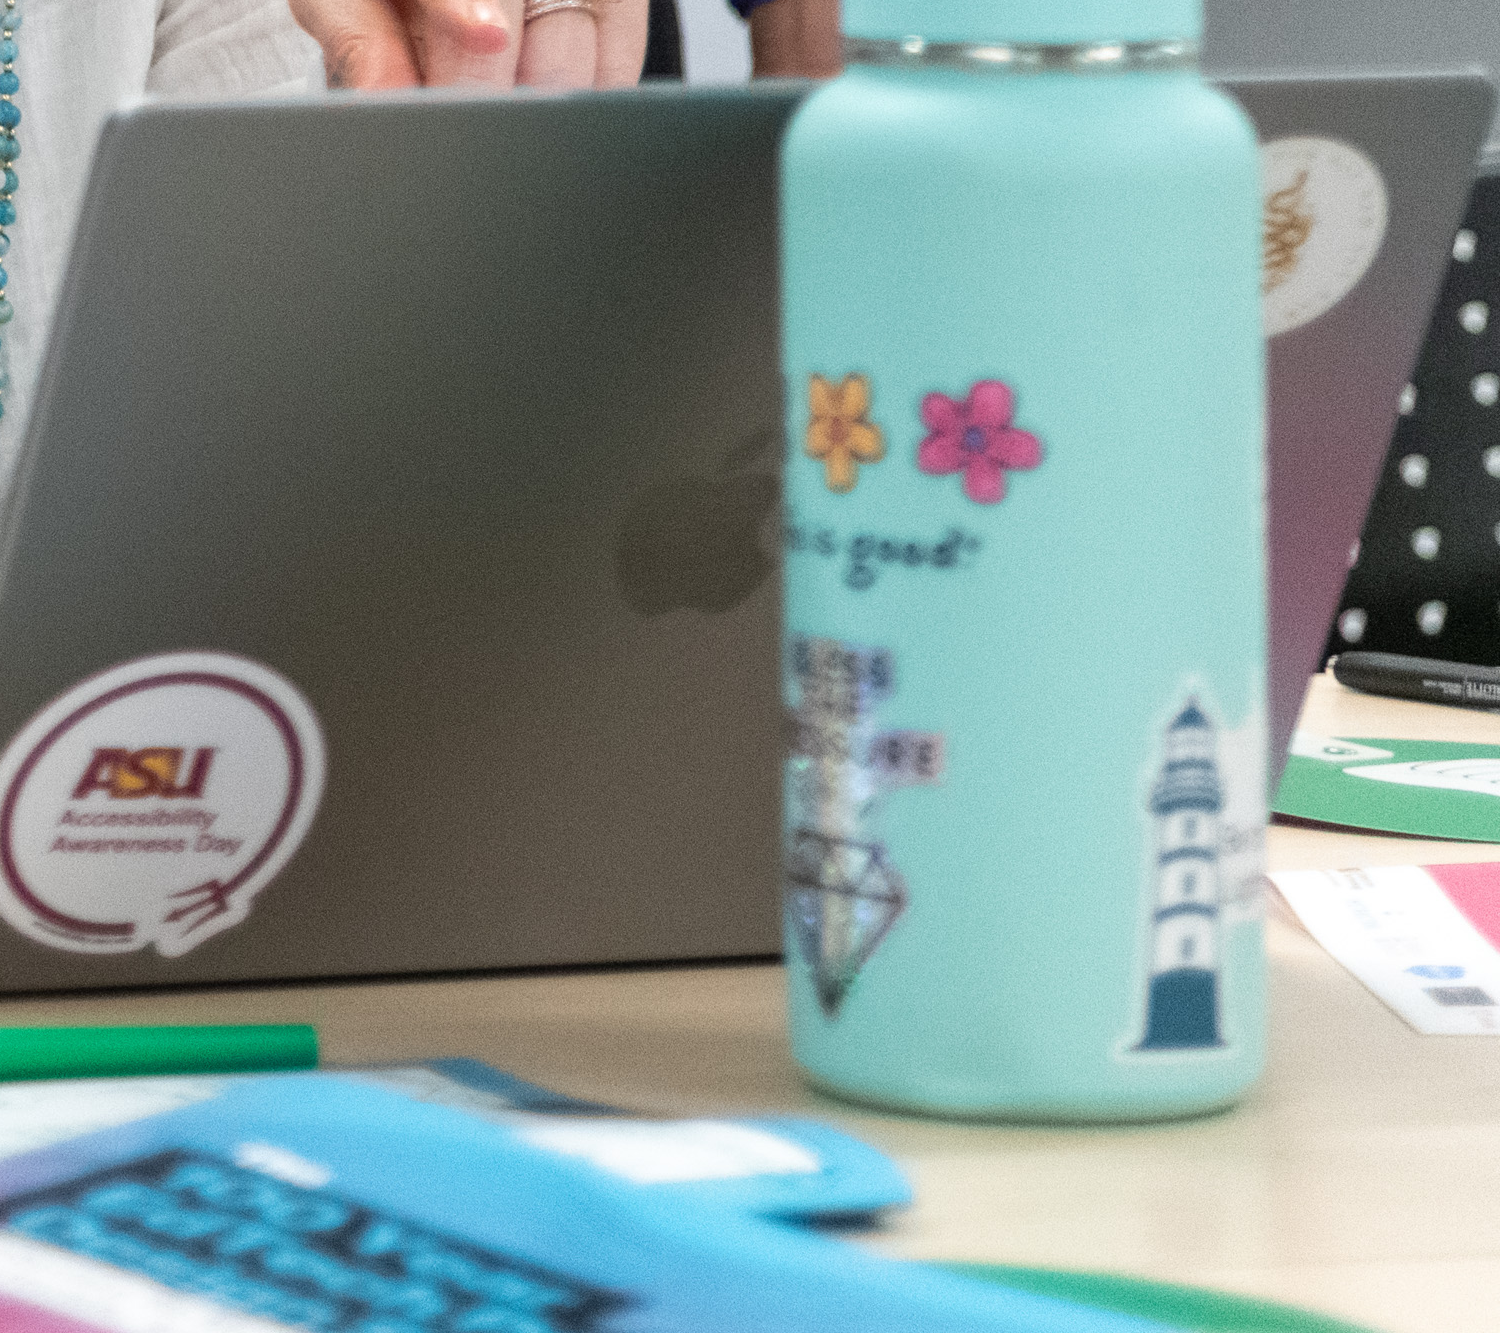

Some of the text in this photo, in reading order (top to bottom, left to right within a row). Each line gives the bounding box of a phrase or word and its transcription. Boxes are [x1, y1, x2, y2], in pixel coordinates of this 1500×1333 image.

[71, 747, 215, 799] ASU
[60, 809, 218, 831] Accessibility
[50, 833, 246, 857] Awareness Day
